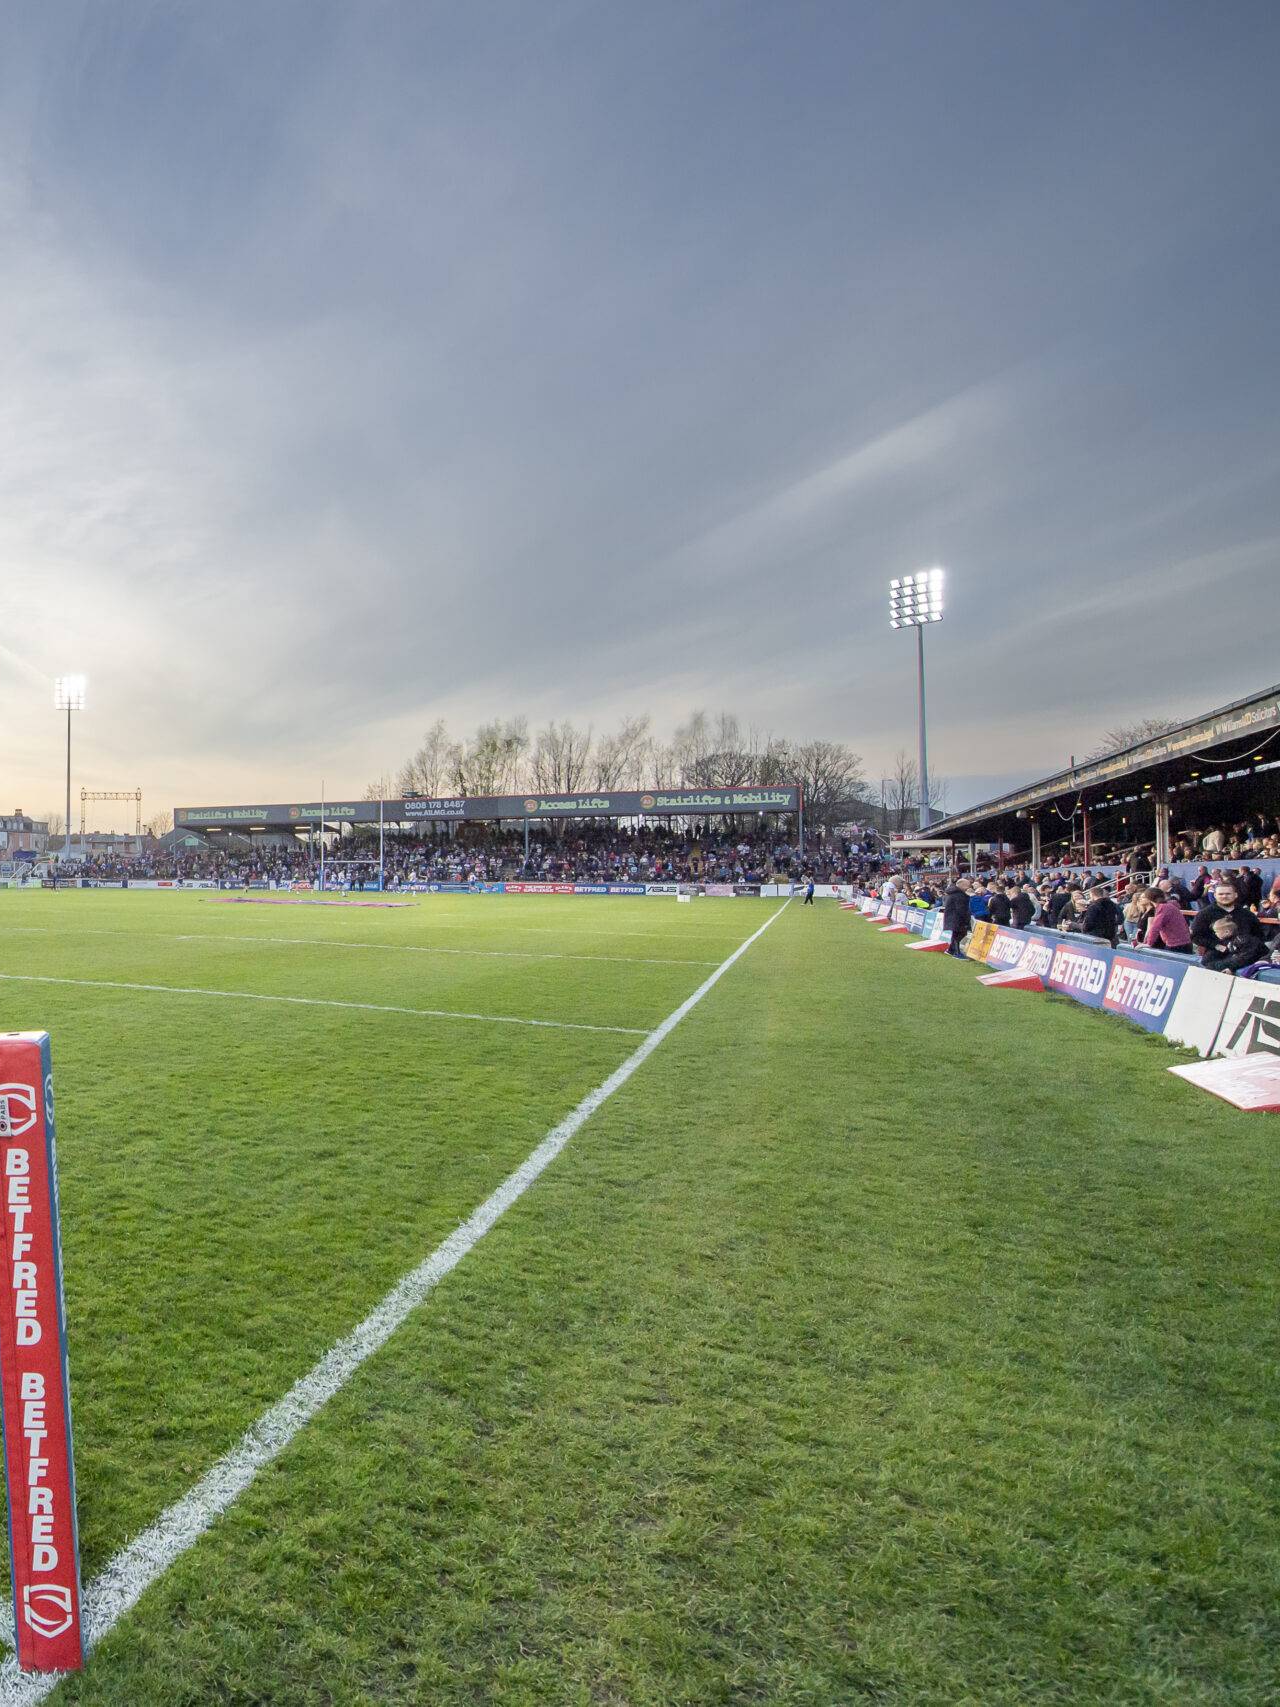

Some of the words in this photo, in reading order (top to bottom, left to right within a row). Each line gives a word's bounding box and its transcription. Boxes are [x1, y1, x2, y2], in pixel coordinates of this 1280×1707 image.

[405, 802, 427, 810] 0808
[539, 800, 577, 810] Access
[578, 799, 610, 809] Lifts
[656, 794, 721, 806] Stairlifts
[733, 792, 791, 806] Mobility
[988, 934, 1026, 965] BETFRED
[1049, 951, 1107, 995] BETFRED
[1105, 964, 1175, 1017] BETFRED
[5, 1148, 43, 1346] BETFRED
[20, 1372, 59, 1572] BETFRED
